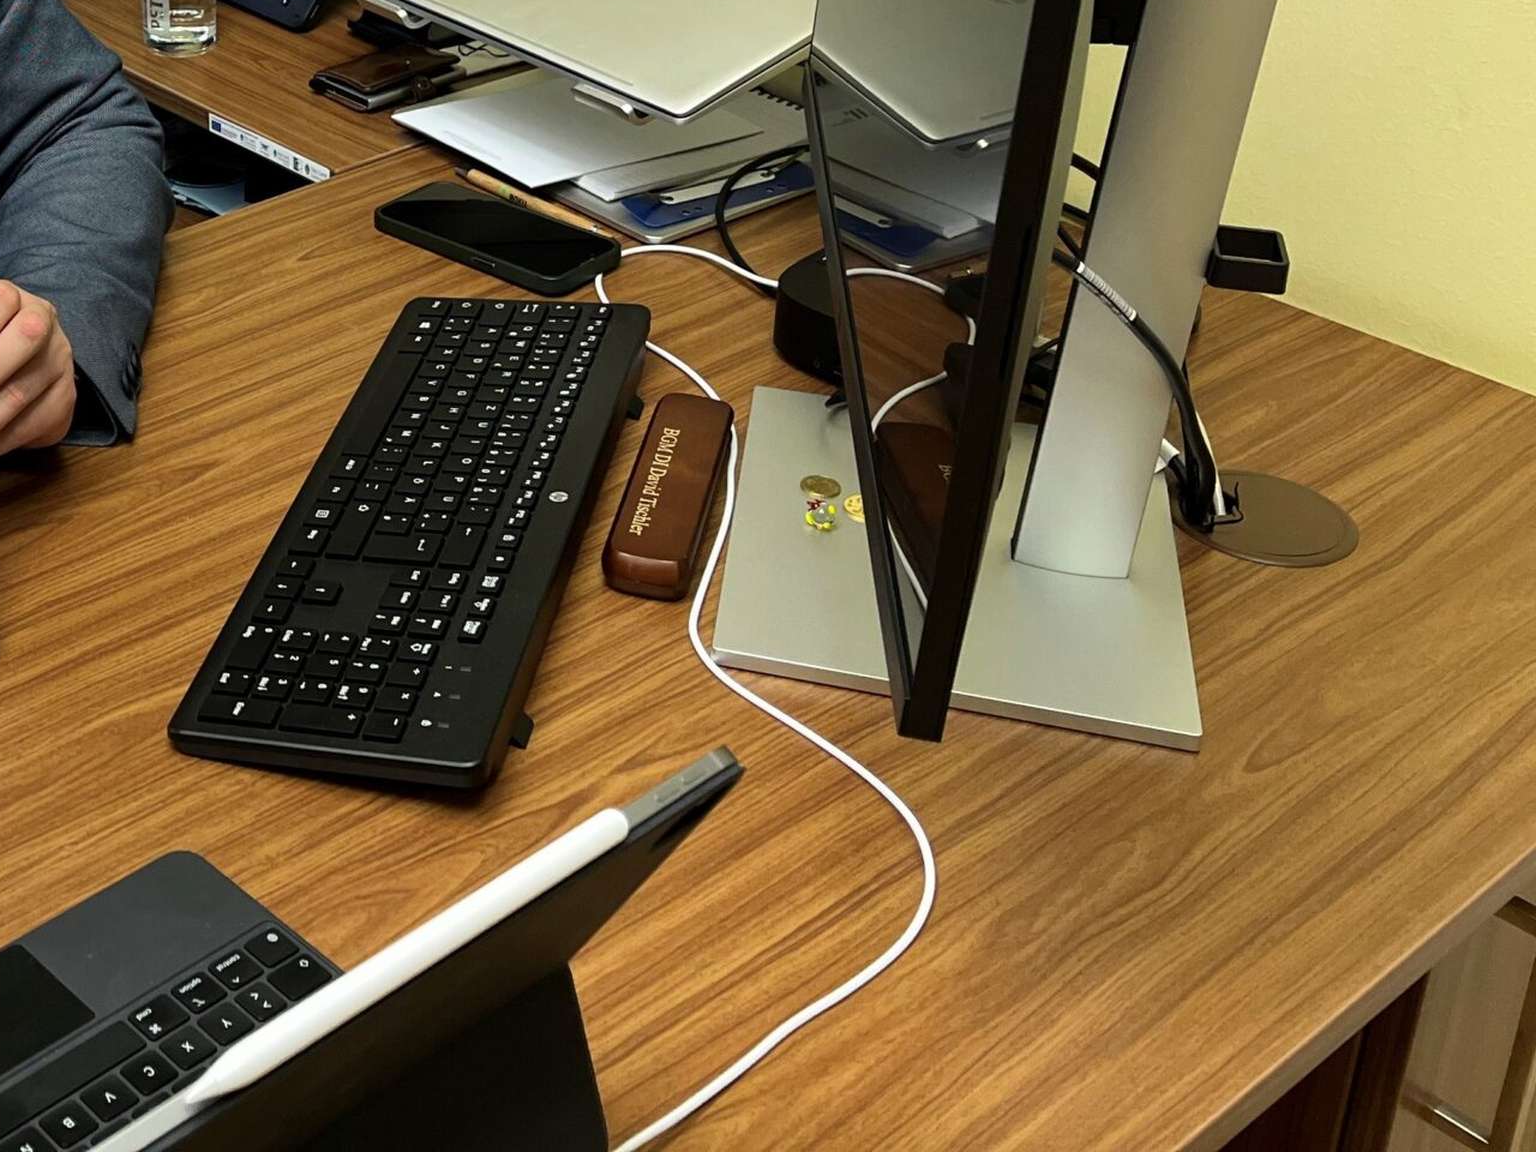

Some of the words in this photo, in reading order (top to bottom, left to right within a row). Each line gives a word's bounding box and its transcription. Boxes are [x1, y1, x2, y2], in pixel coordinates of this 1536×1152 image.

[657, 427, 681, 454] BGM
[652, 453, 671, 467] DI
[642, 467, 667, 497] David
[629, 497, 657, 536] Tischler
[179, 977, 202, 993] option
[136, 1008, 152, 1022] cmd
[221, 1018, 232, 1029] Y
[181, 1040, 194, 1052] X
[143, 1066, 155, 1077] C
[105, 1091, 117, 1103] V
[63, 1117, 75, 1129] B
